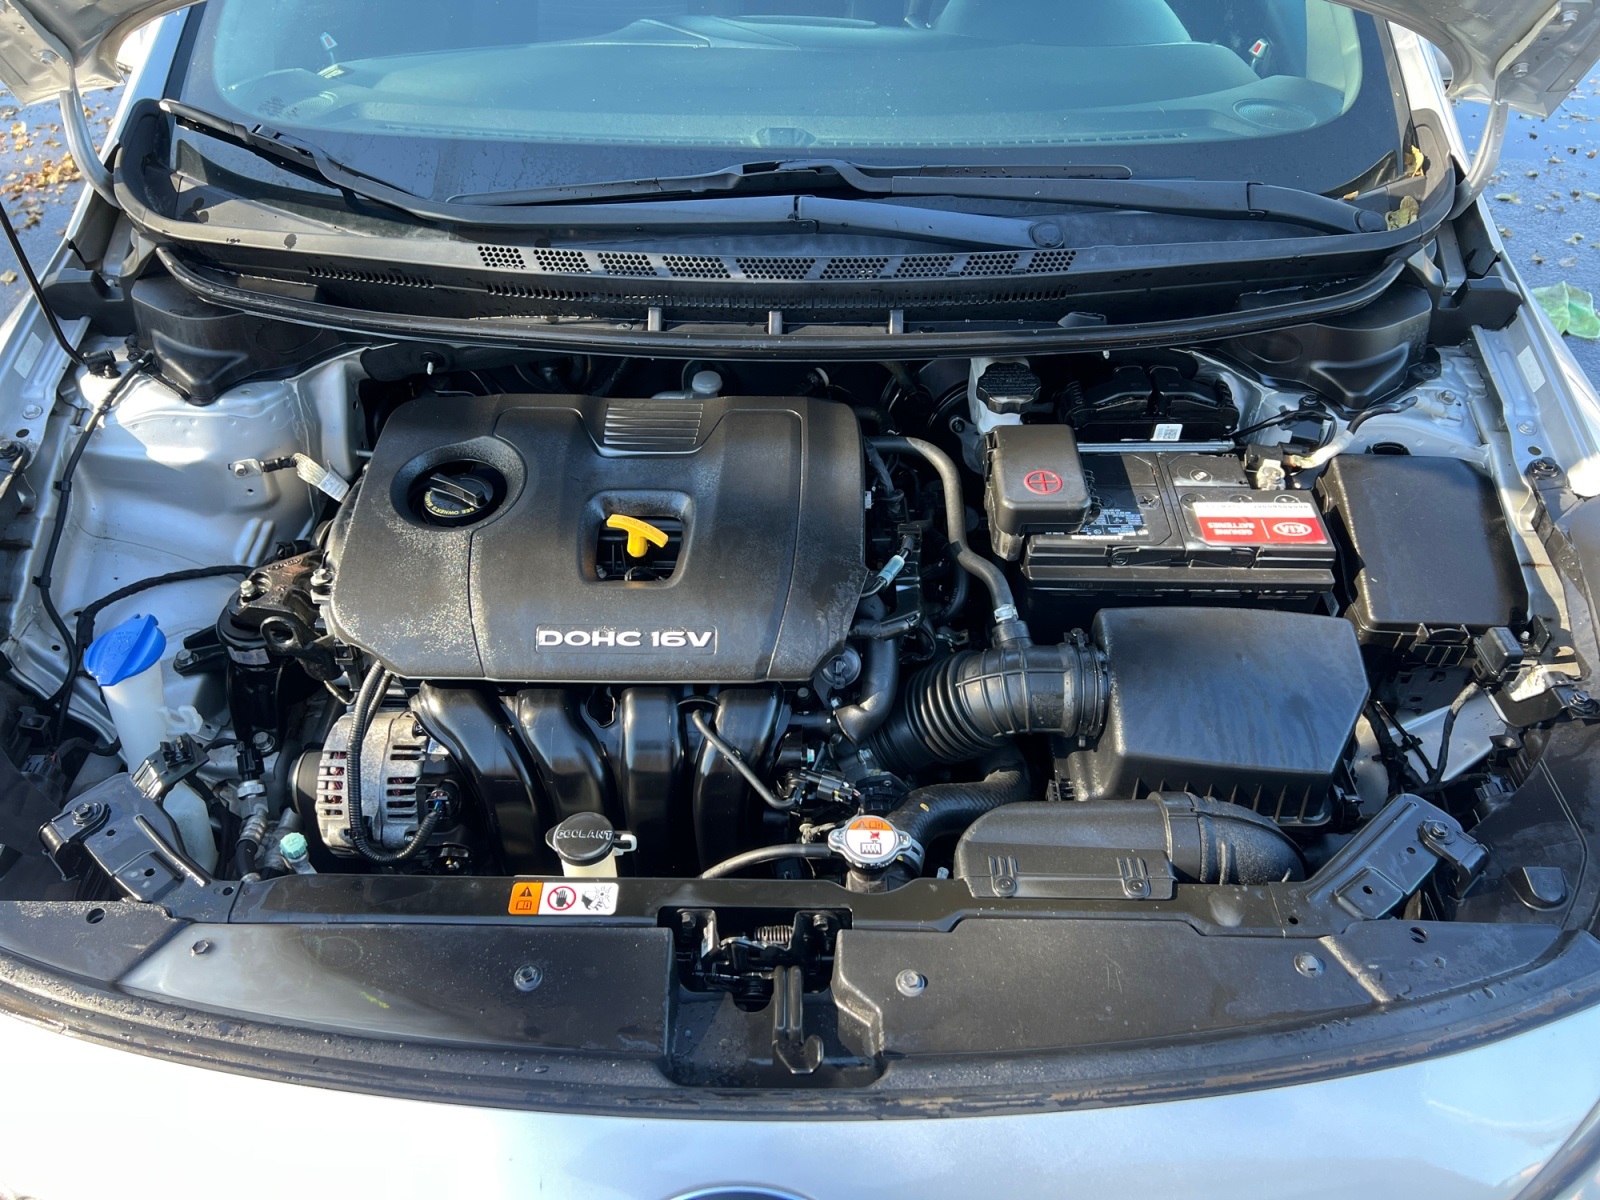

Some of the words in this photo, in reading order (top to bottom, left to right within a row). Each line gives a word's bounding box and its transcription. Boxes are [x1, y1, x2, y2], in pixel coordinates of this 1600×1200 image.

[1278, 523, 1309, 534] KIA
[538, 630, 642, 647] DOHC
[651, 631, 713, 648] 16V
[556, 829, 613, 840] COOLANT
